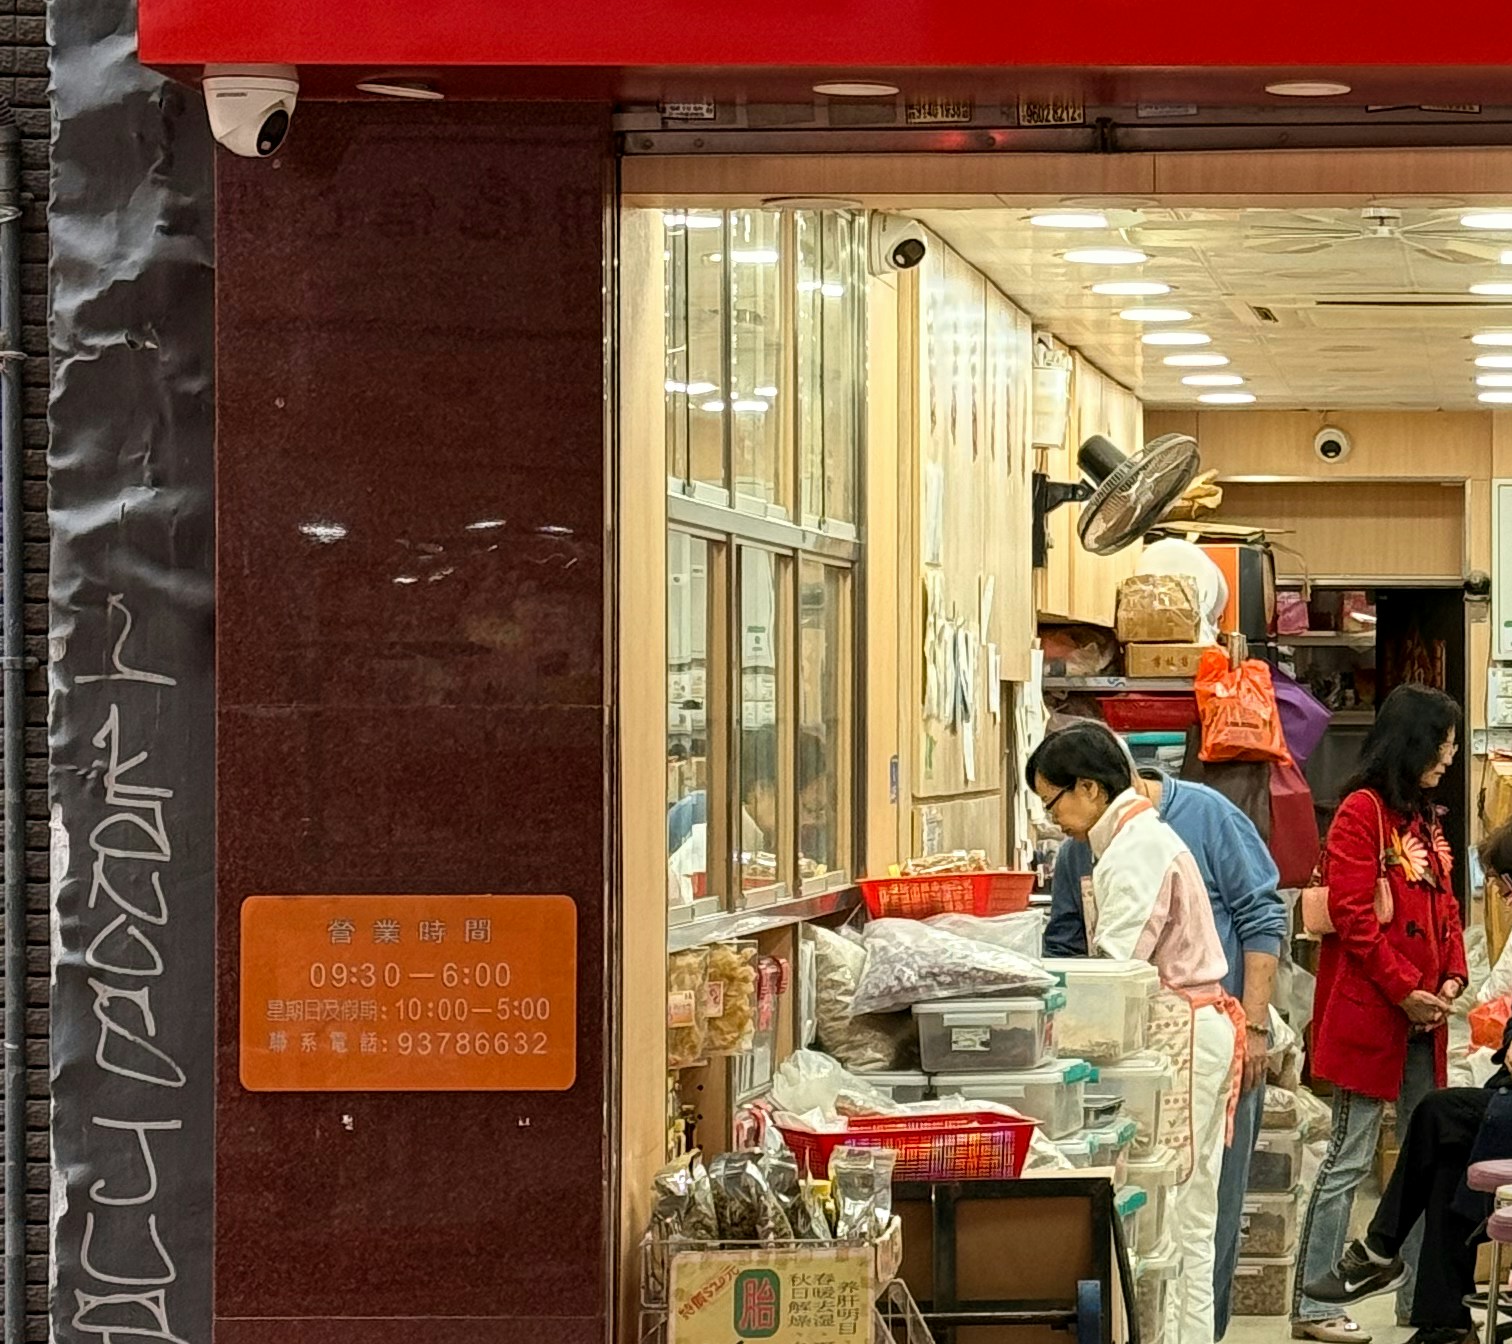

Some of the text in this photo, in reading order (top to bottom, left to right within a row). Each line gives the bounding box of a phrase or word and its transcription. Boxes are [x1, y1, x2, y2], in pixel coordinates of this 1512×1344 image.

[327, 919, 492, 944] 營業時間
[398, 1031, 548, 1055] 93786632
[740, 1278, 776, 1330] 胎
